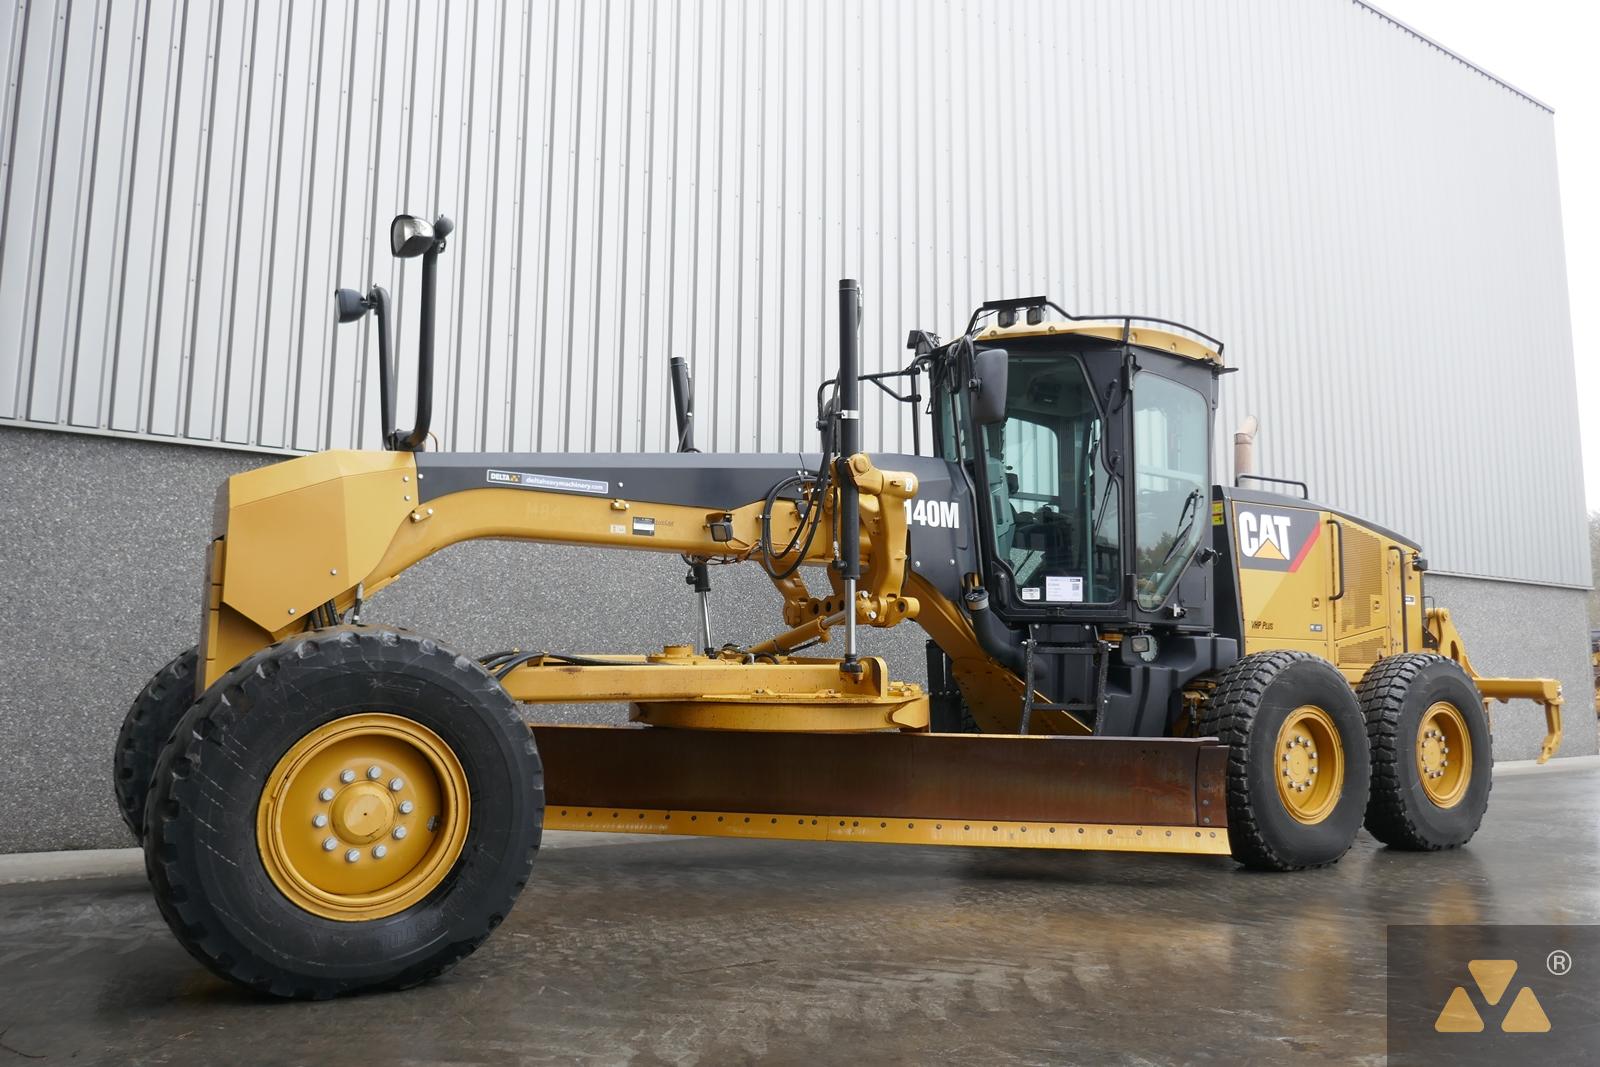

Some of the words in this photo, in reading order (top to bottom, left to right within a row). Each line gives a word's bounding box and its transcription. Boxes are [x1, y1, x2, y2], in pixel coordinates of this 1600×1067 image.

[490, 473, 510, 481] DELTA
[526, 477, 603, 490] deltaheavymachinery.com
[904, 499, 959, 528] 140M
[1239, 511, 1291, 560] CAT
